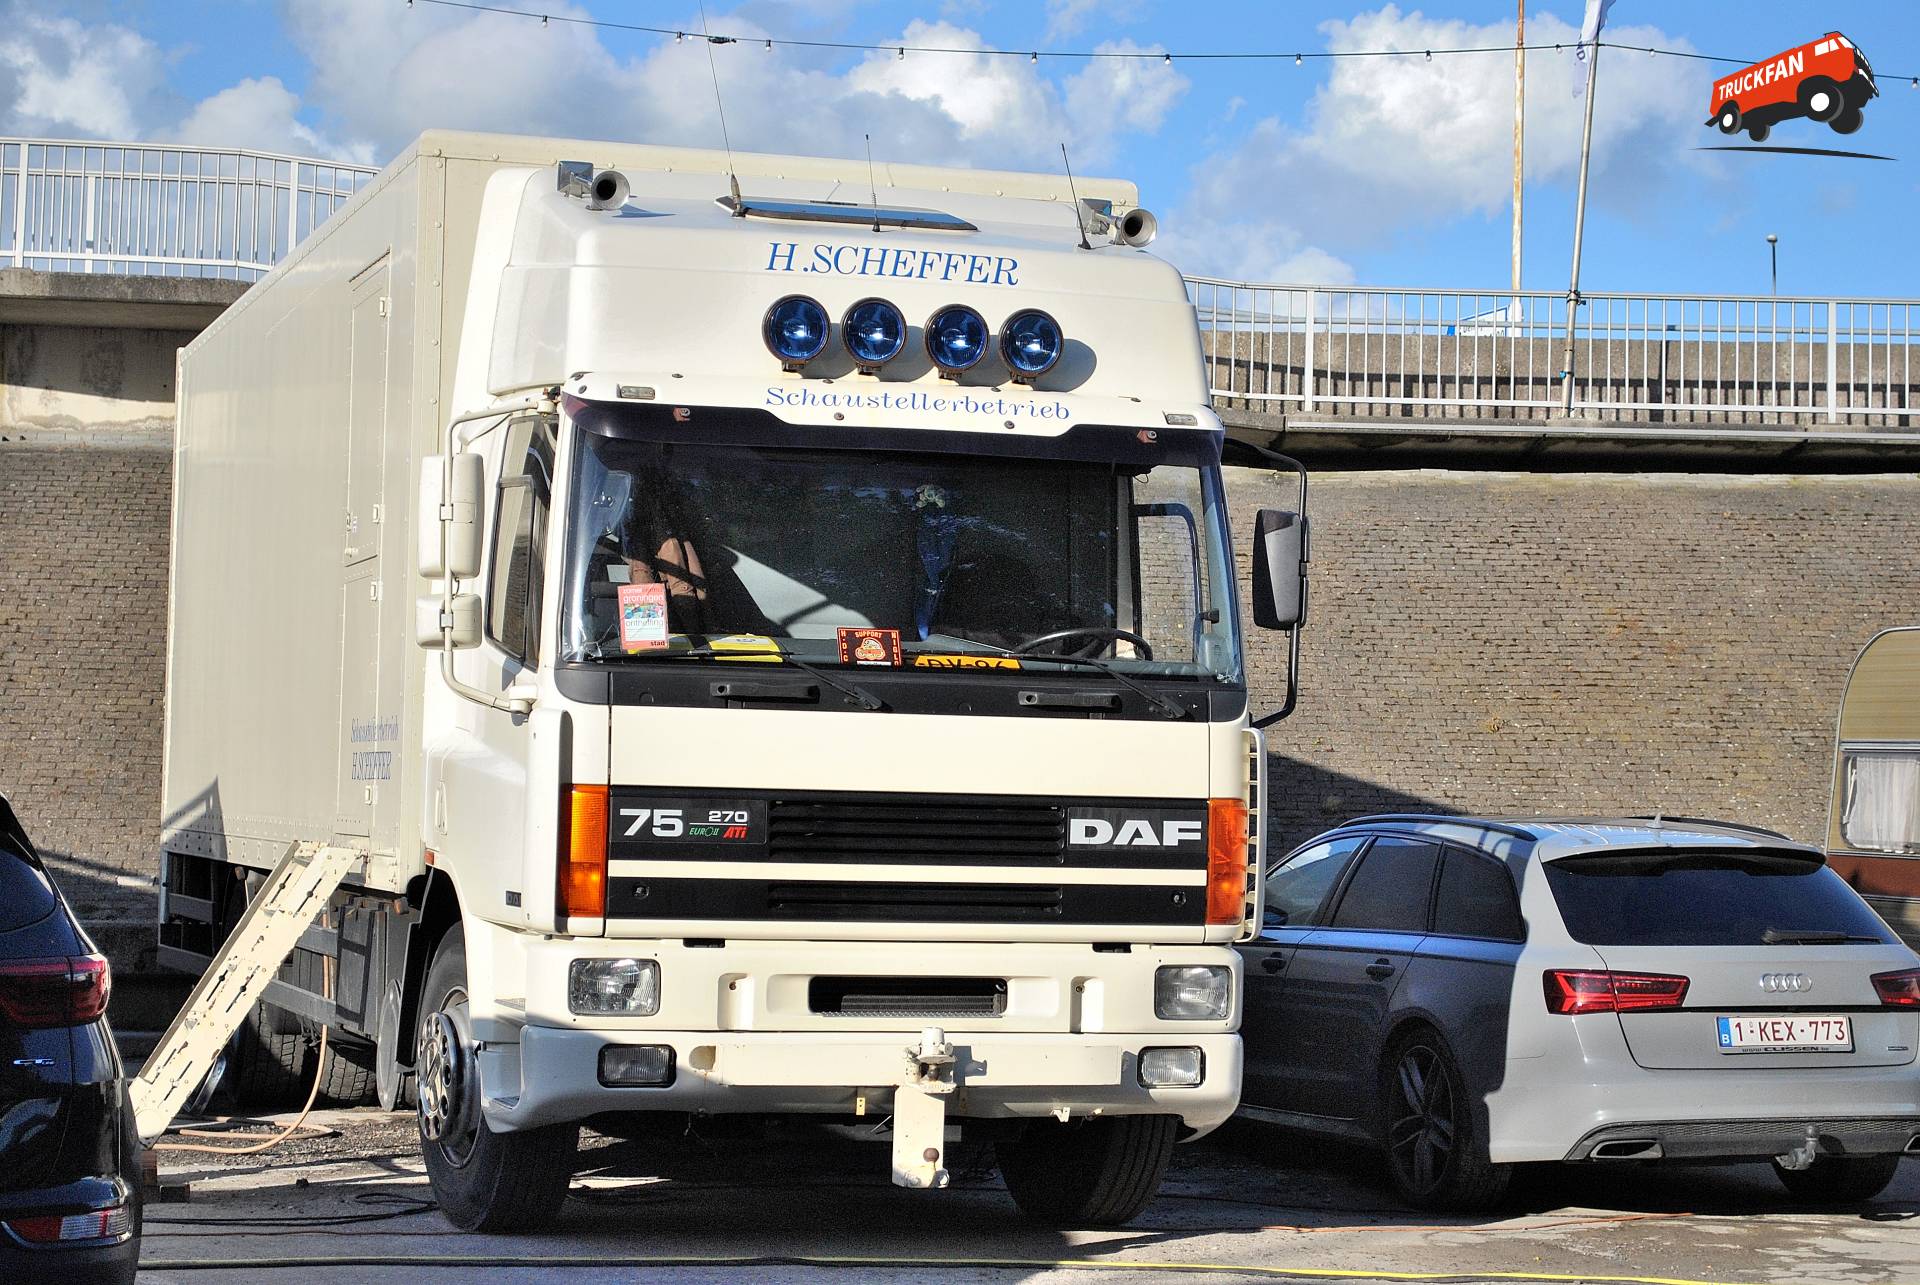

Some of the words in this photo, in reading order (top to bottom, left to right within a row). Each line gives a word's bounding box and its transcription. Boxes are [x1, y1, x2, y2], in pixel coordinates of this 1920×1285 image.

[765, 242, 1019, 286] H.SCHEFFER
[765, 386, 1070, 420] Schaustellerbetrieb
[623, 595, 664, 604] groningen
[854, 631, 883, 639] SUPPORT
[619, 808, 684, 838] 75
[708, 810, 748, 823] 270
[1069, 818, 1202, 847] DAF
[1721, 1033, 1731, 1044] B
